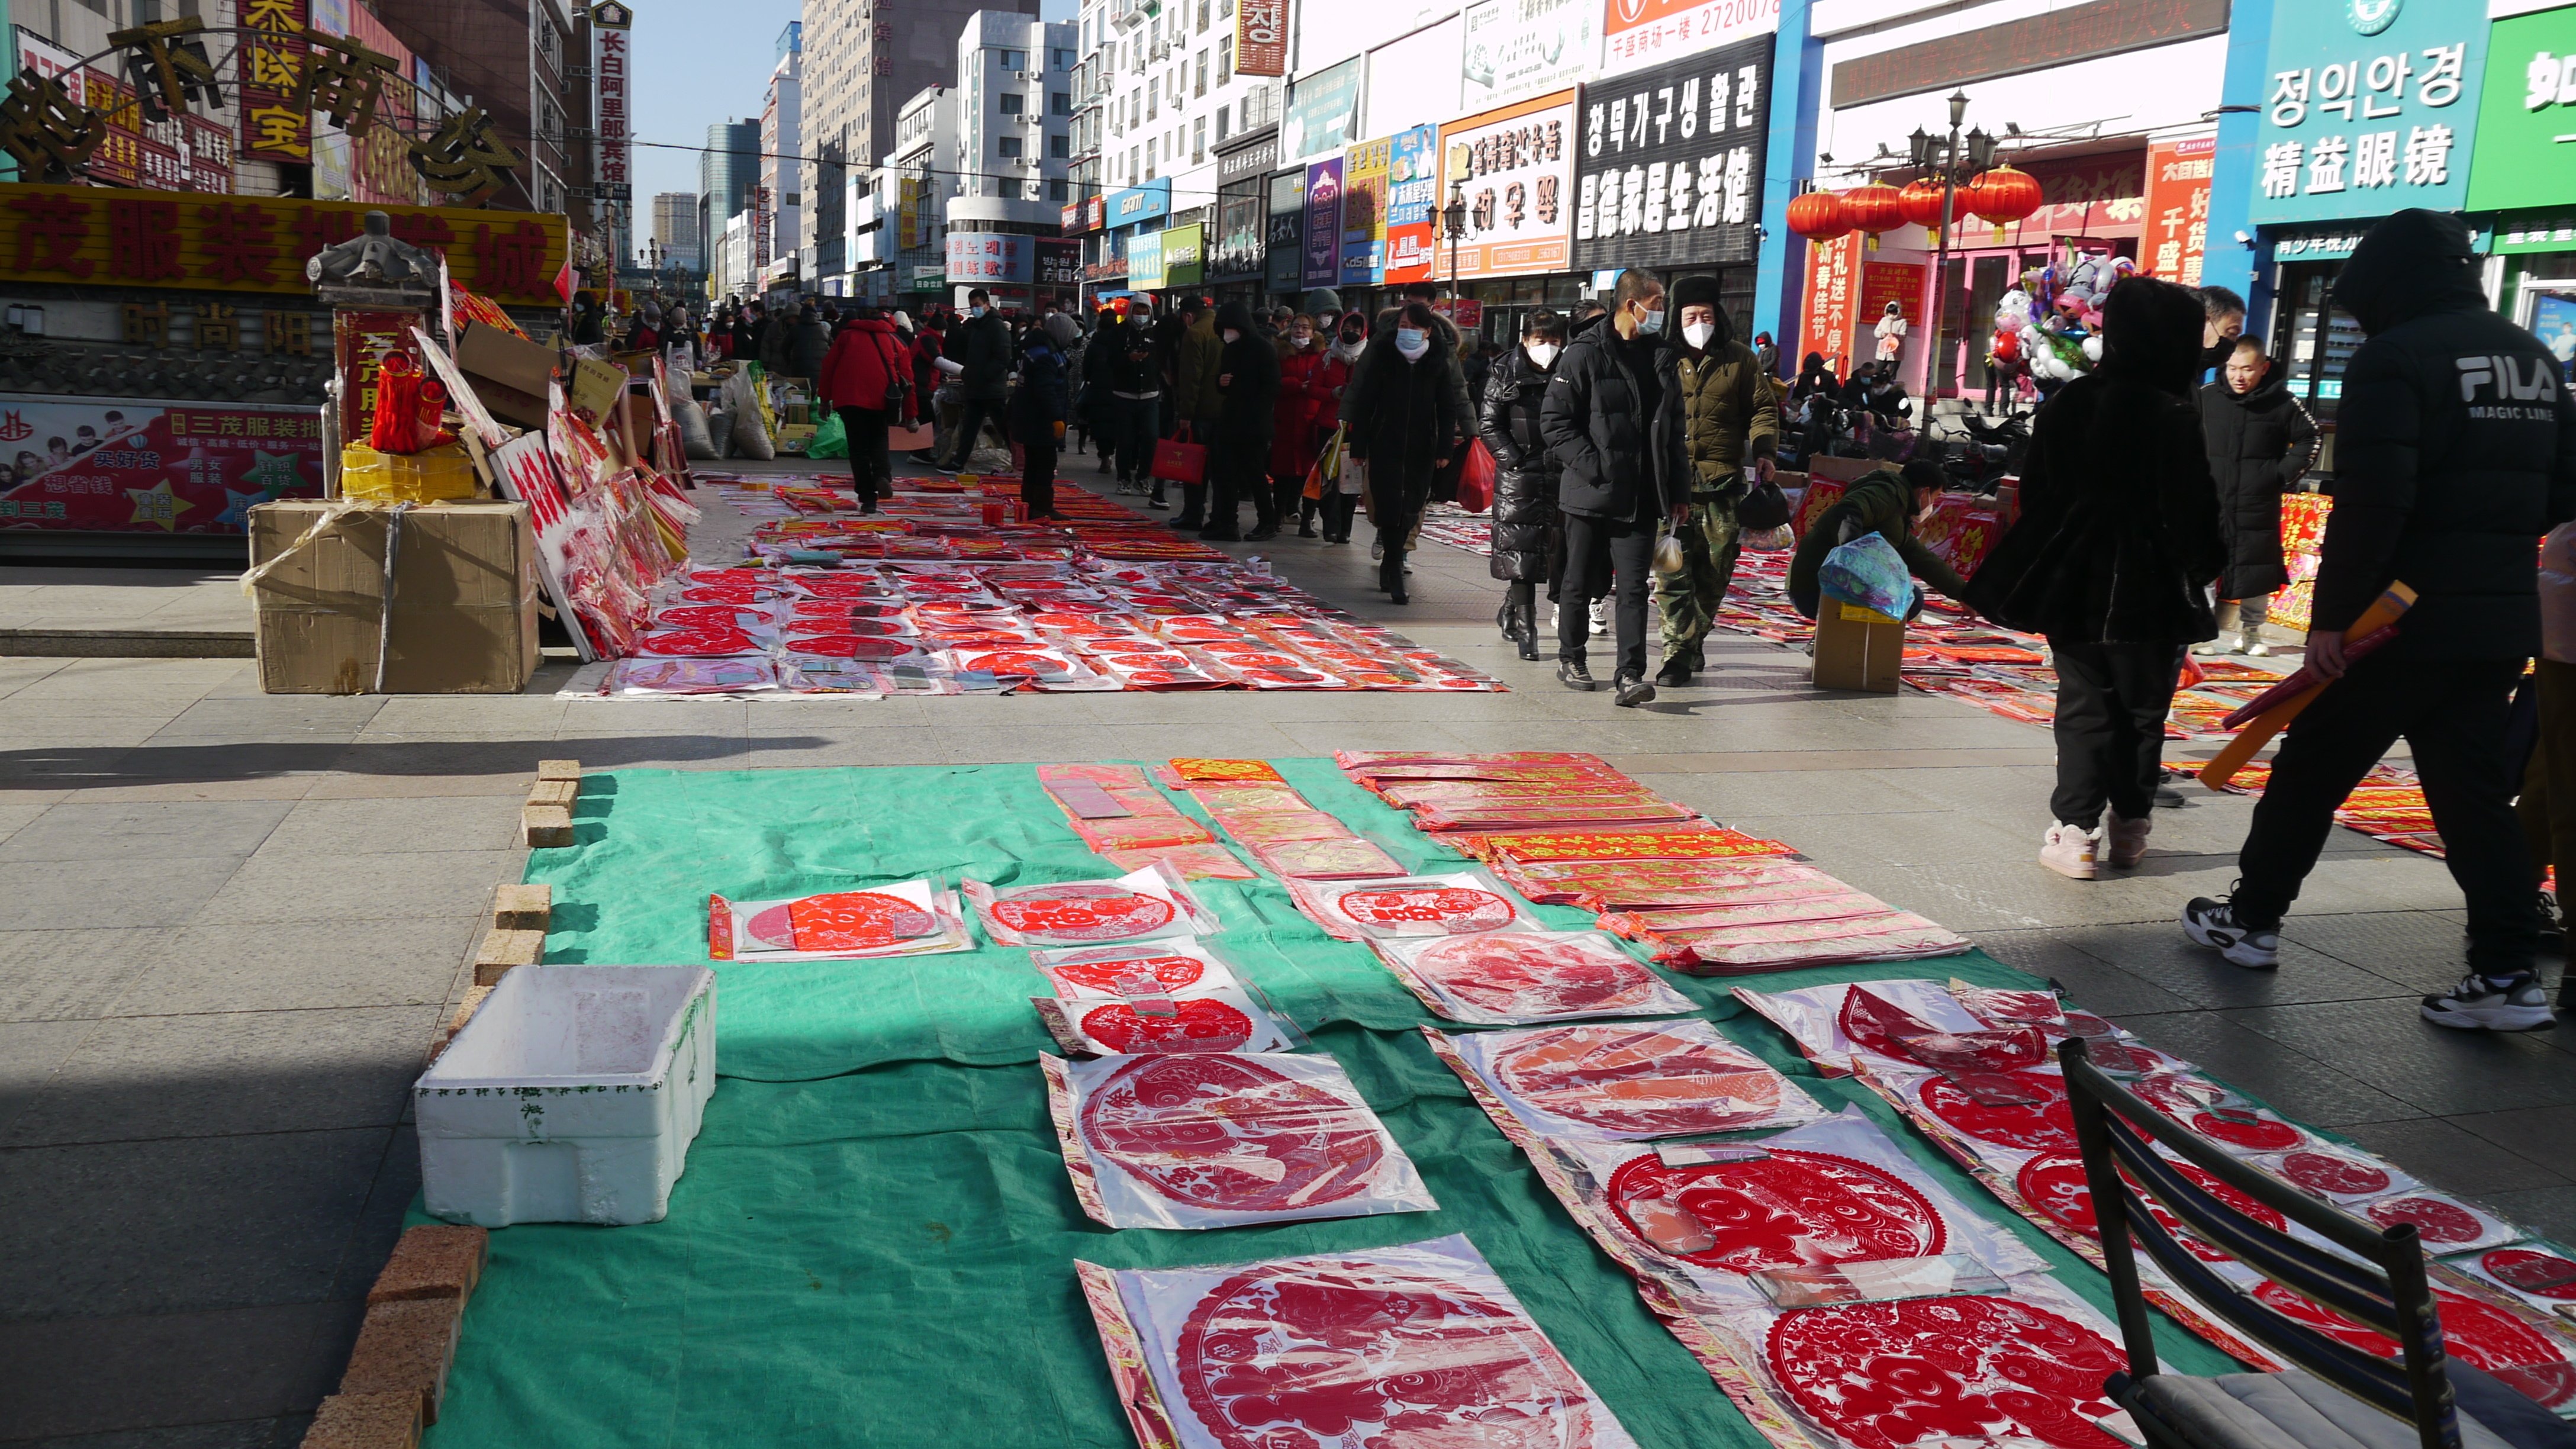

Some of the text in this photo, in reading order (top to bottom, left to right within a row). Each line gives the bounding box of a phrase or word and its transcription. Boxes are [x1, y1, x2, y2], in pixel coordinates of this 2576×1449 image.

[1614, 15, 1690, 61] 千盛商场一楼
[2270, 41, 2466, 127] 정익안경
[600, 31, 626, 183] 长白阿里郎宾馆
[1588, 65, 1757, 156] 창덕가구생활관
[2262, 124, 2453, 198] 精益眼镜
[1121, 192, 1146, 215] GIANT
[1448, 175, 1559, 228] 甜孕婴
[1577, 146, 1750, 240] 昌德家居生活馆
[123, 300, 312, 356] 时尚阳
[2455, 355, 2558, 402] FILA
[2470, 407, 2556, 421] MAGIC LINE
[95, 450, 160, 469] 买好货
[189, 458, 222, 471] 男女
[259, 459, 292, 474] 针织
[44, 474, 114, 495] 想省钱
[190, 472, 223, 485] 服装
[260, 474, 292, 487] 百货
[0, 500, 67, 520] 到三茂
[138, 494, 172, 507] 童装
